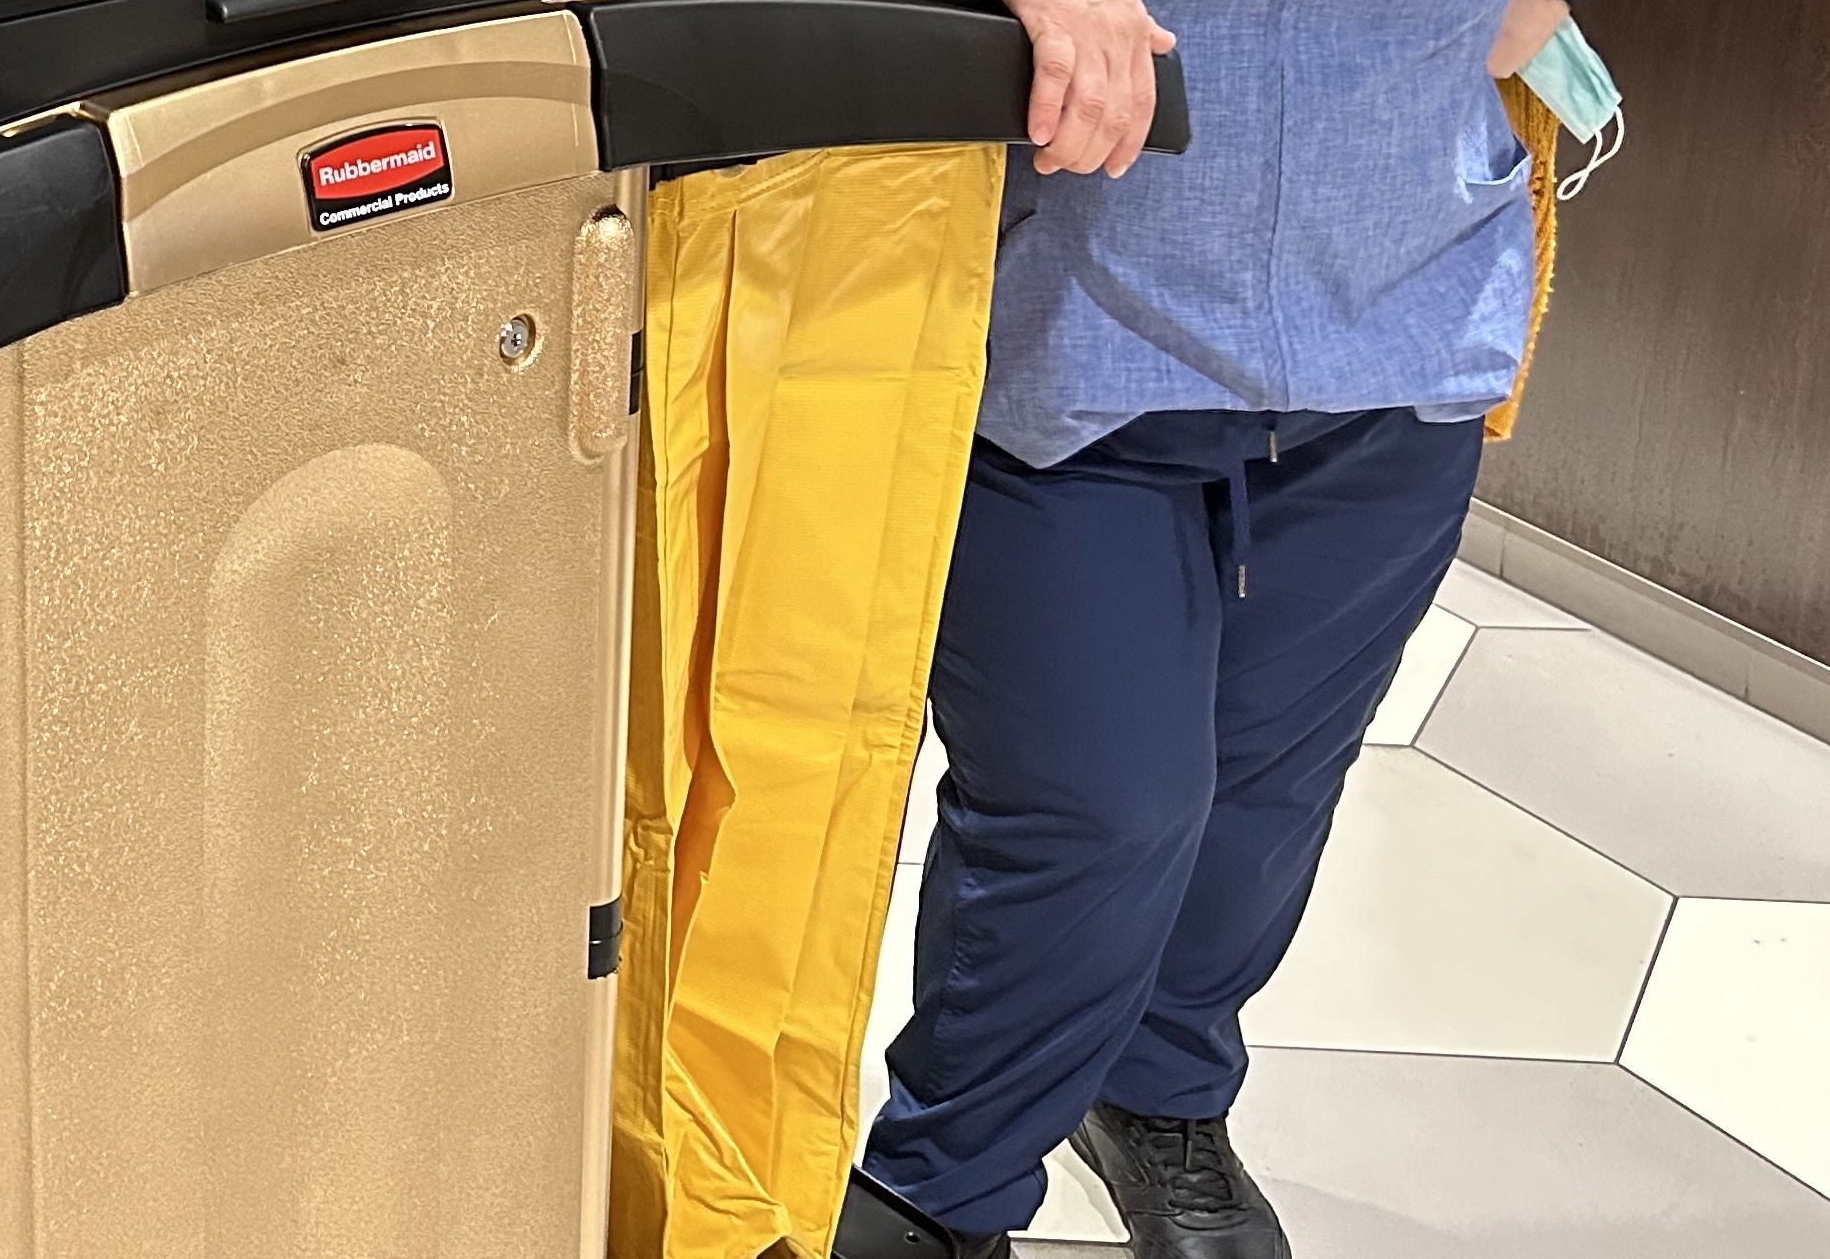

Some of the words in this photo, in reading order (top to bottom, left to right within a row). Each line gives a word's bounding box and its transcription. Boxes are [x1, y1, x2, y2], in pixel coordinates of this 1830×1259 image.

[320, 141, 436, 187] Rubbermaid
[320, 195, 393, 225] Commercial
[395, 182, 450, 206] Products
